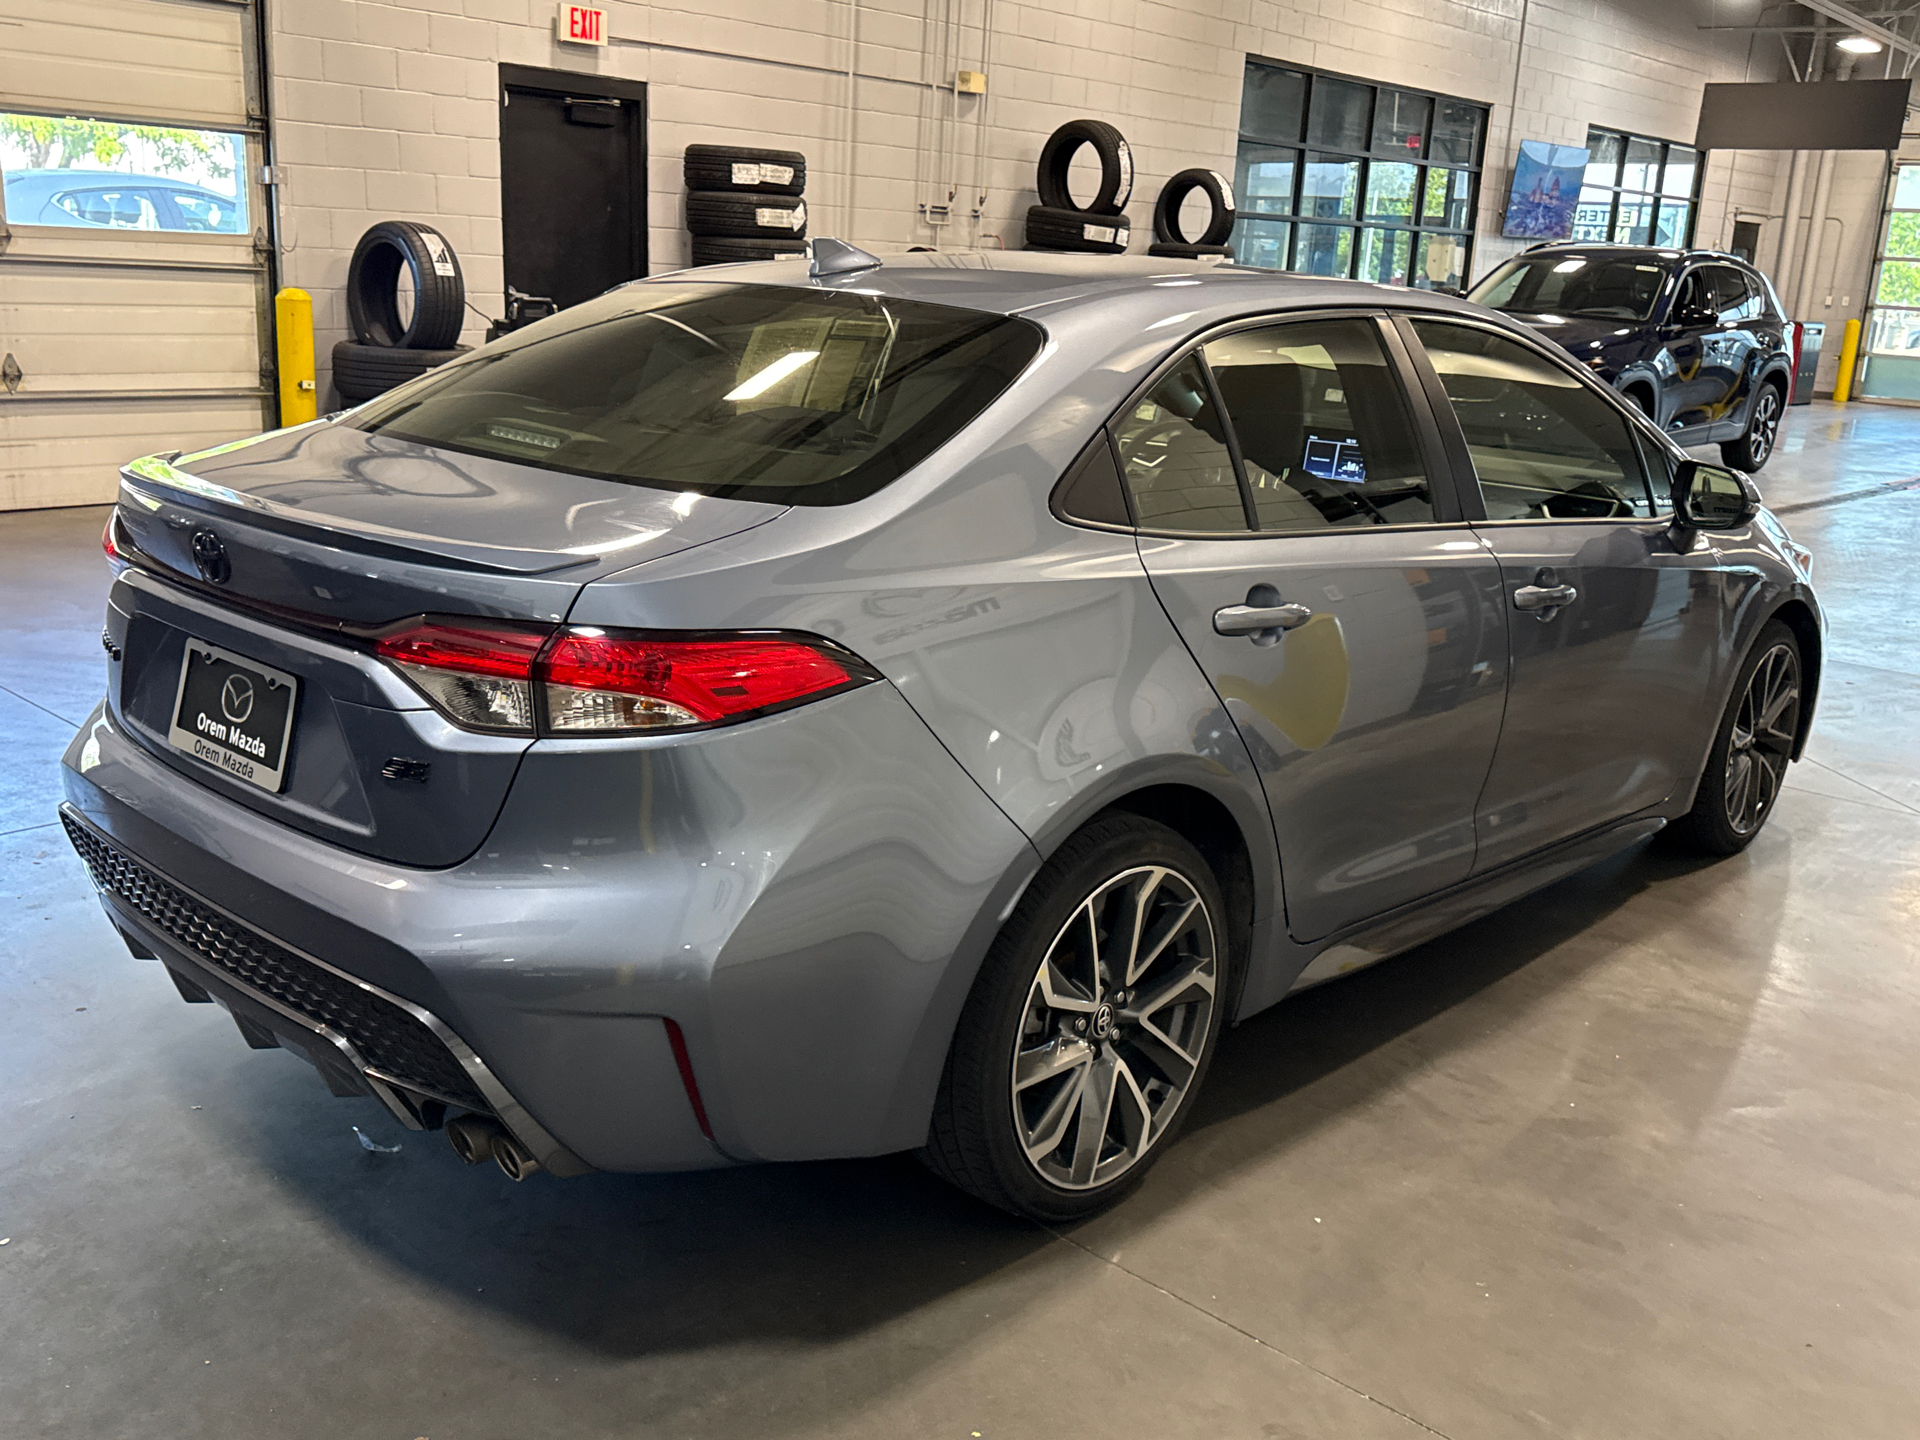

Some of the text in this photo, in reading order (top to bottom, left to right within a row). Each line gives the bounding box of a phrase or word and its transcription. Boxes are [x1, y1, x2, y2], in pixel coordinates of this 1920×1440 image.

[570, 7, 602, 41] EXIT
[197, 712, 266, 758] Orem Mazda
[194, 739, 254, 779] Orem Mazda
